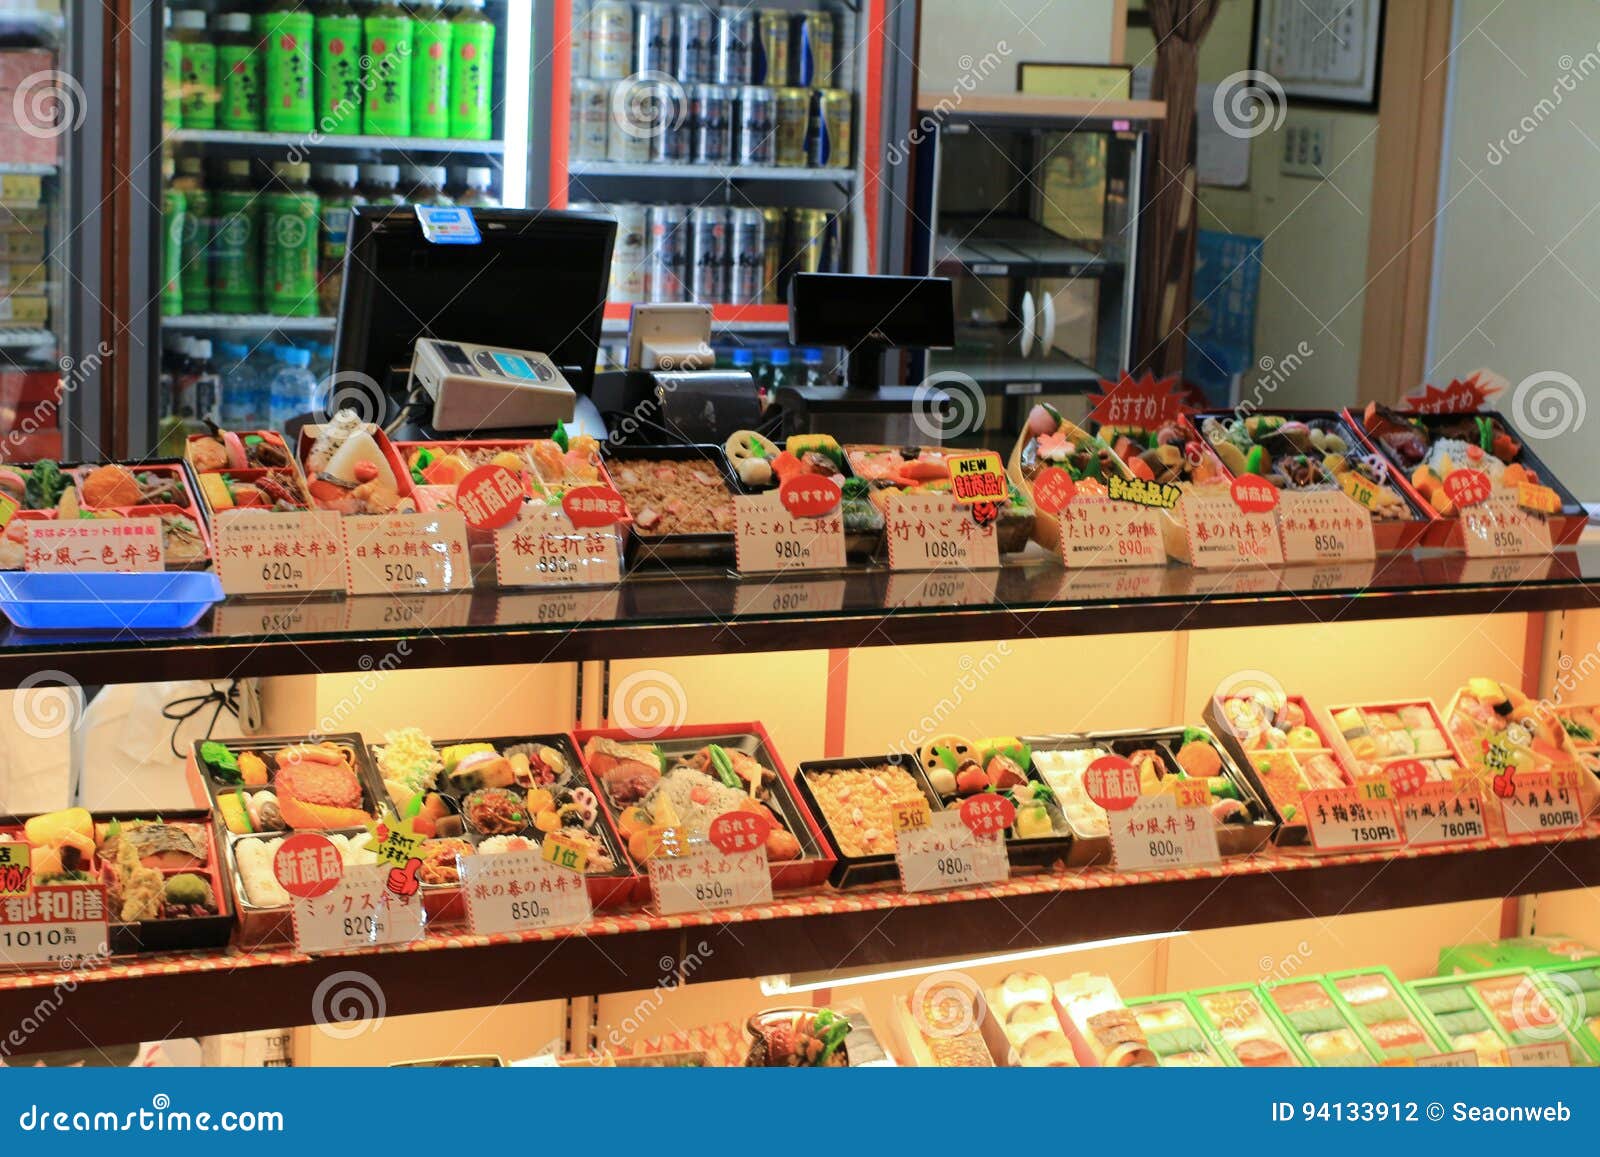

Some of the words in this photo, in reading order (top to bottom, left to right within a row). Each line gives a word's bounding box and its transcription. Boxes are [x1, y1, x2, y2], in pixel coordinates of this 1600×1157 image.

[1109, 394, 1167, 421] おすすめ!
[960, 458, 988, 473] NEW
[459, 467, 524, 525] 新商品
[787, 490, 835, 503] おすすめ
[1108, 474, 1183, 509] 新商品!!
[1235, 485, 1275, 502] 新商品
[744, 519, 841, 536] たこめし二段重
[1314, 534, 1344, 551] 850円
[1494, 531, 1522, 547] 850円
[29, 543, 161, 565] 和風二色弁当
[356, 540, 463, 559] 日本の朝食当
[775, 541, 810, 558] 980円
[924, 541, 967, 558] 1080円
[262, 561, 303, 581] 620円
[1087, 767, 1140, 799] 新商品
[898, 809, 927, 828] 5位
[1128, 815, 1196, 838] 和風弁当
[1540, 810, 1575, 826] 800円
[1351, 826, 1392, 842] 750円
[1441, 821, 1478, 838] 780円
[552, 845, 580, 869] 1位
[1149, 840, 1183, 857] 800円
[276, 845, 342, 886] 新商品
[937, 857, 972, 875] 980円
[474, 875, 583, 901] 旅の幕の内弁当
[696, 881, 733, 901] 850円
[512, 900, 550, 920] 850円
[344, 915, 385, 937] 820円
[266, 1035, 290, 1047] TOP
